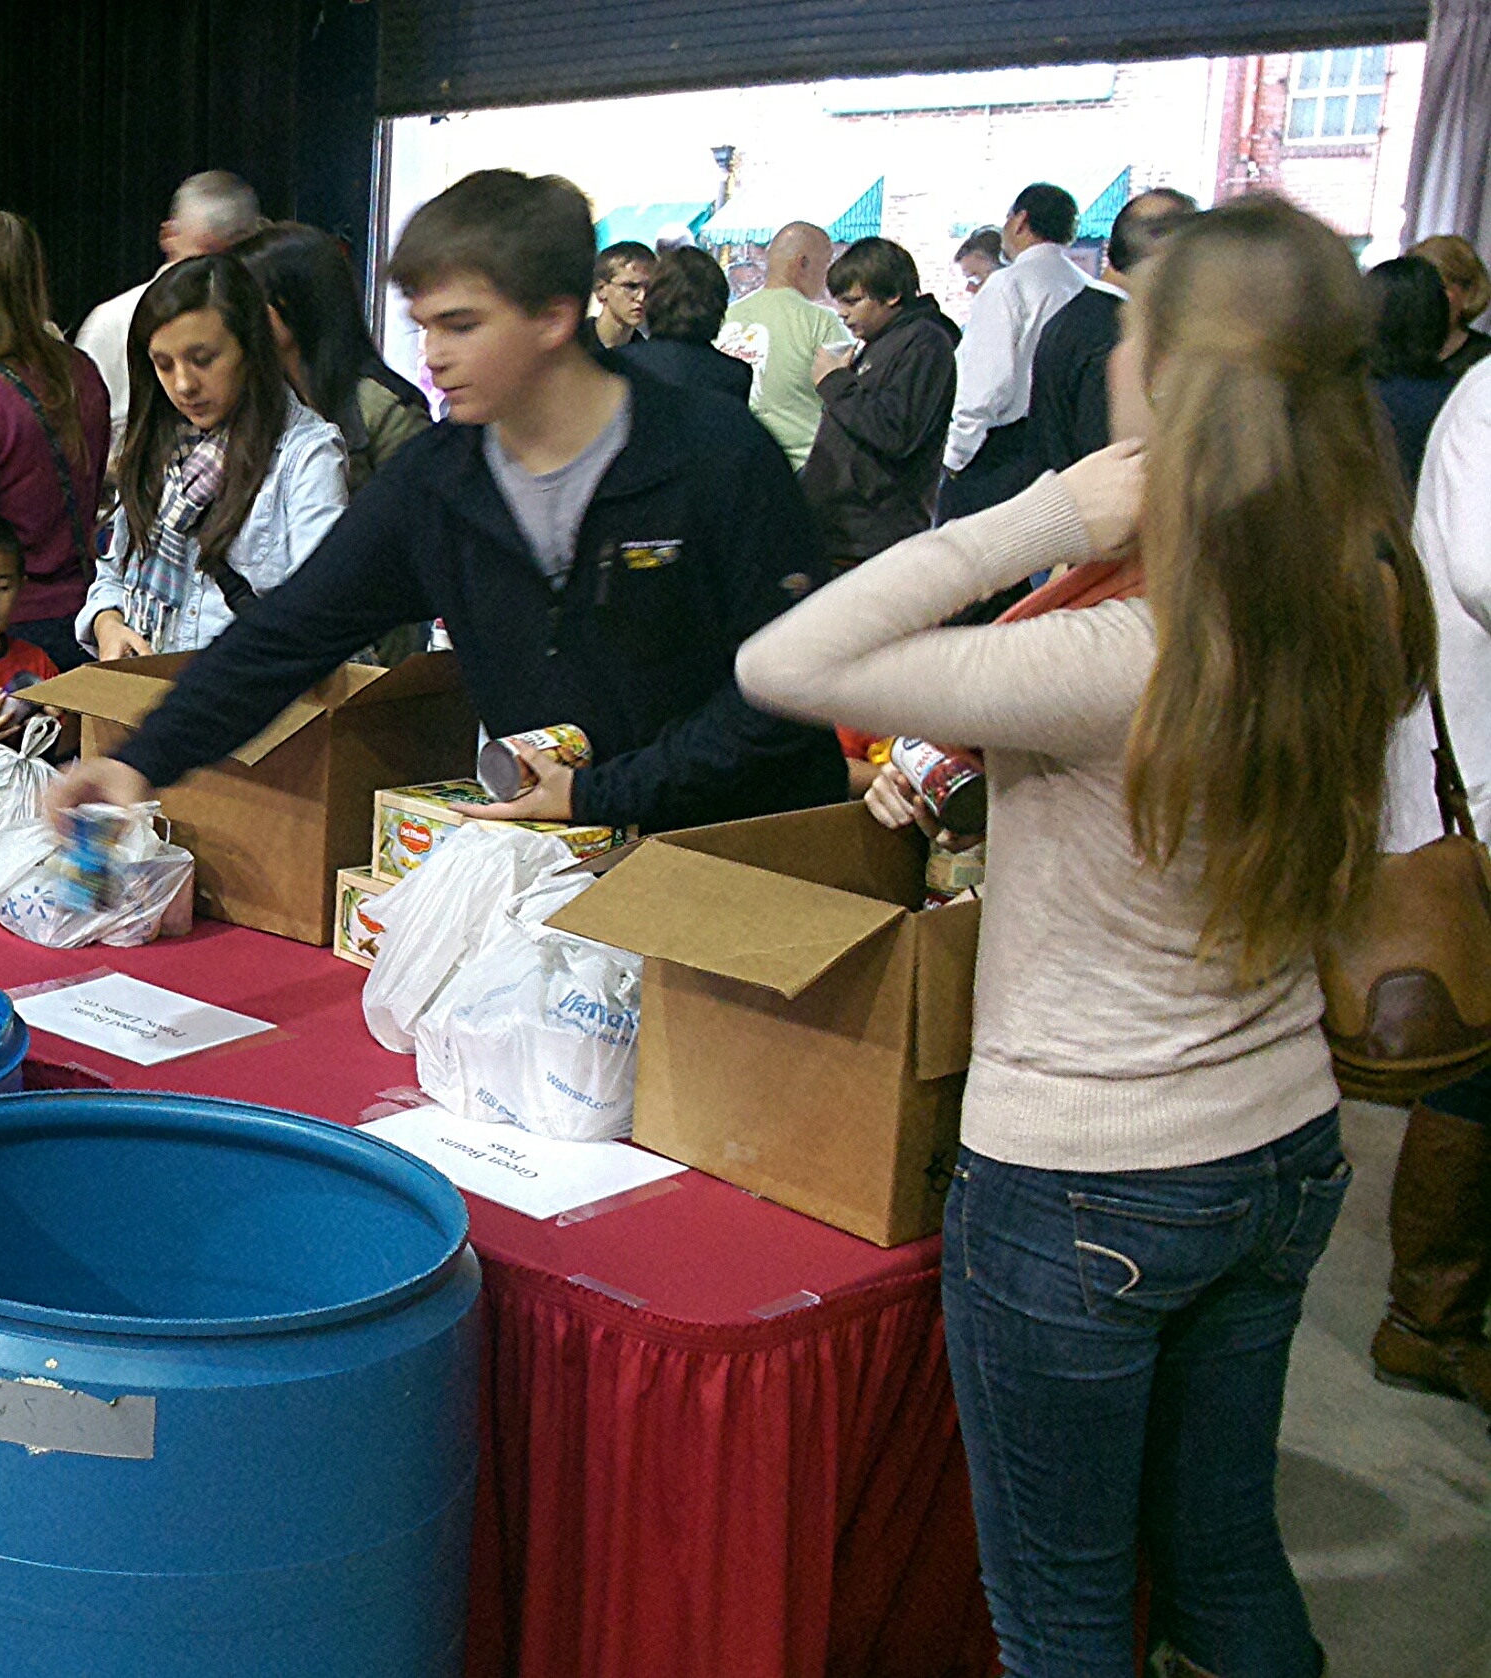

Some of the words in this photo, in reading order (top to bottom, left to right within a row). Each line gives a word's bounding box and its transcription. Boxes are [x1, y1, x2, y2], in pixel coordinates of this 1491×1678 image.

[401, 827, 410, 836] Del
[410, 829, 430, 842] Monte
[437, 1137, 487, 1159] Beans
[487, 1142, 527, 1161] Peas
[488, 1156, 539, 1179] Green
